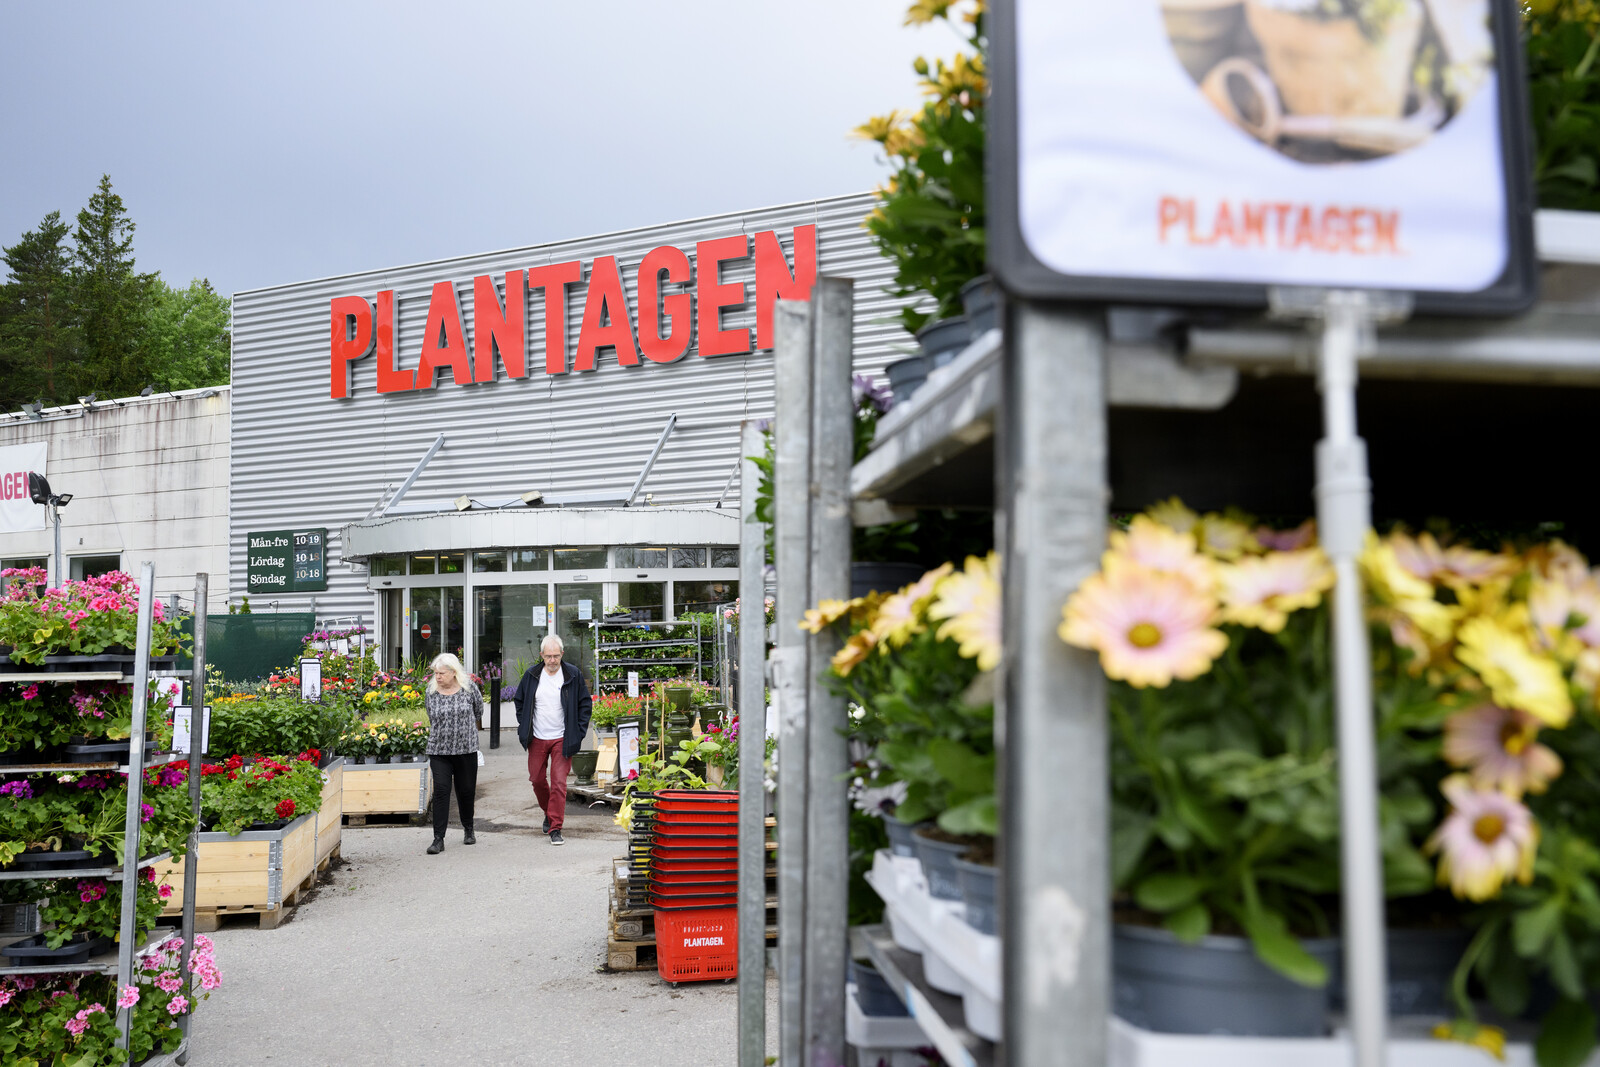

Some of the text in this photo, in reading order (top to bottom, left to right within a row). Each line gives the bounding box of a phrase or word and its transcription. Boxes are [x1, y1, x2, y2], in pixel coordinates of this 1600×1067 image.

[331, 224, 817, 399] PLANTAGEN
[250, 535, 320, 548] Mån-fre 10-19
[250, 556, 286, 568] Lördag
[250, 568, 320, 586] Söndag 10-18
